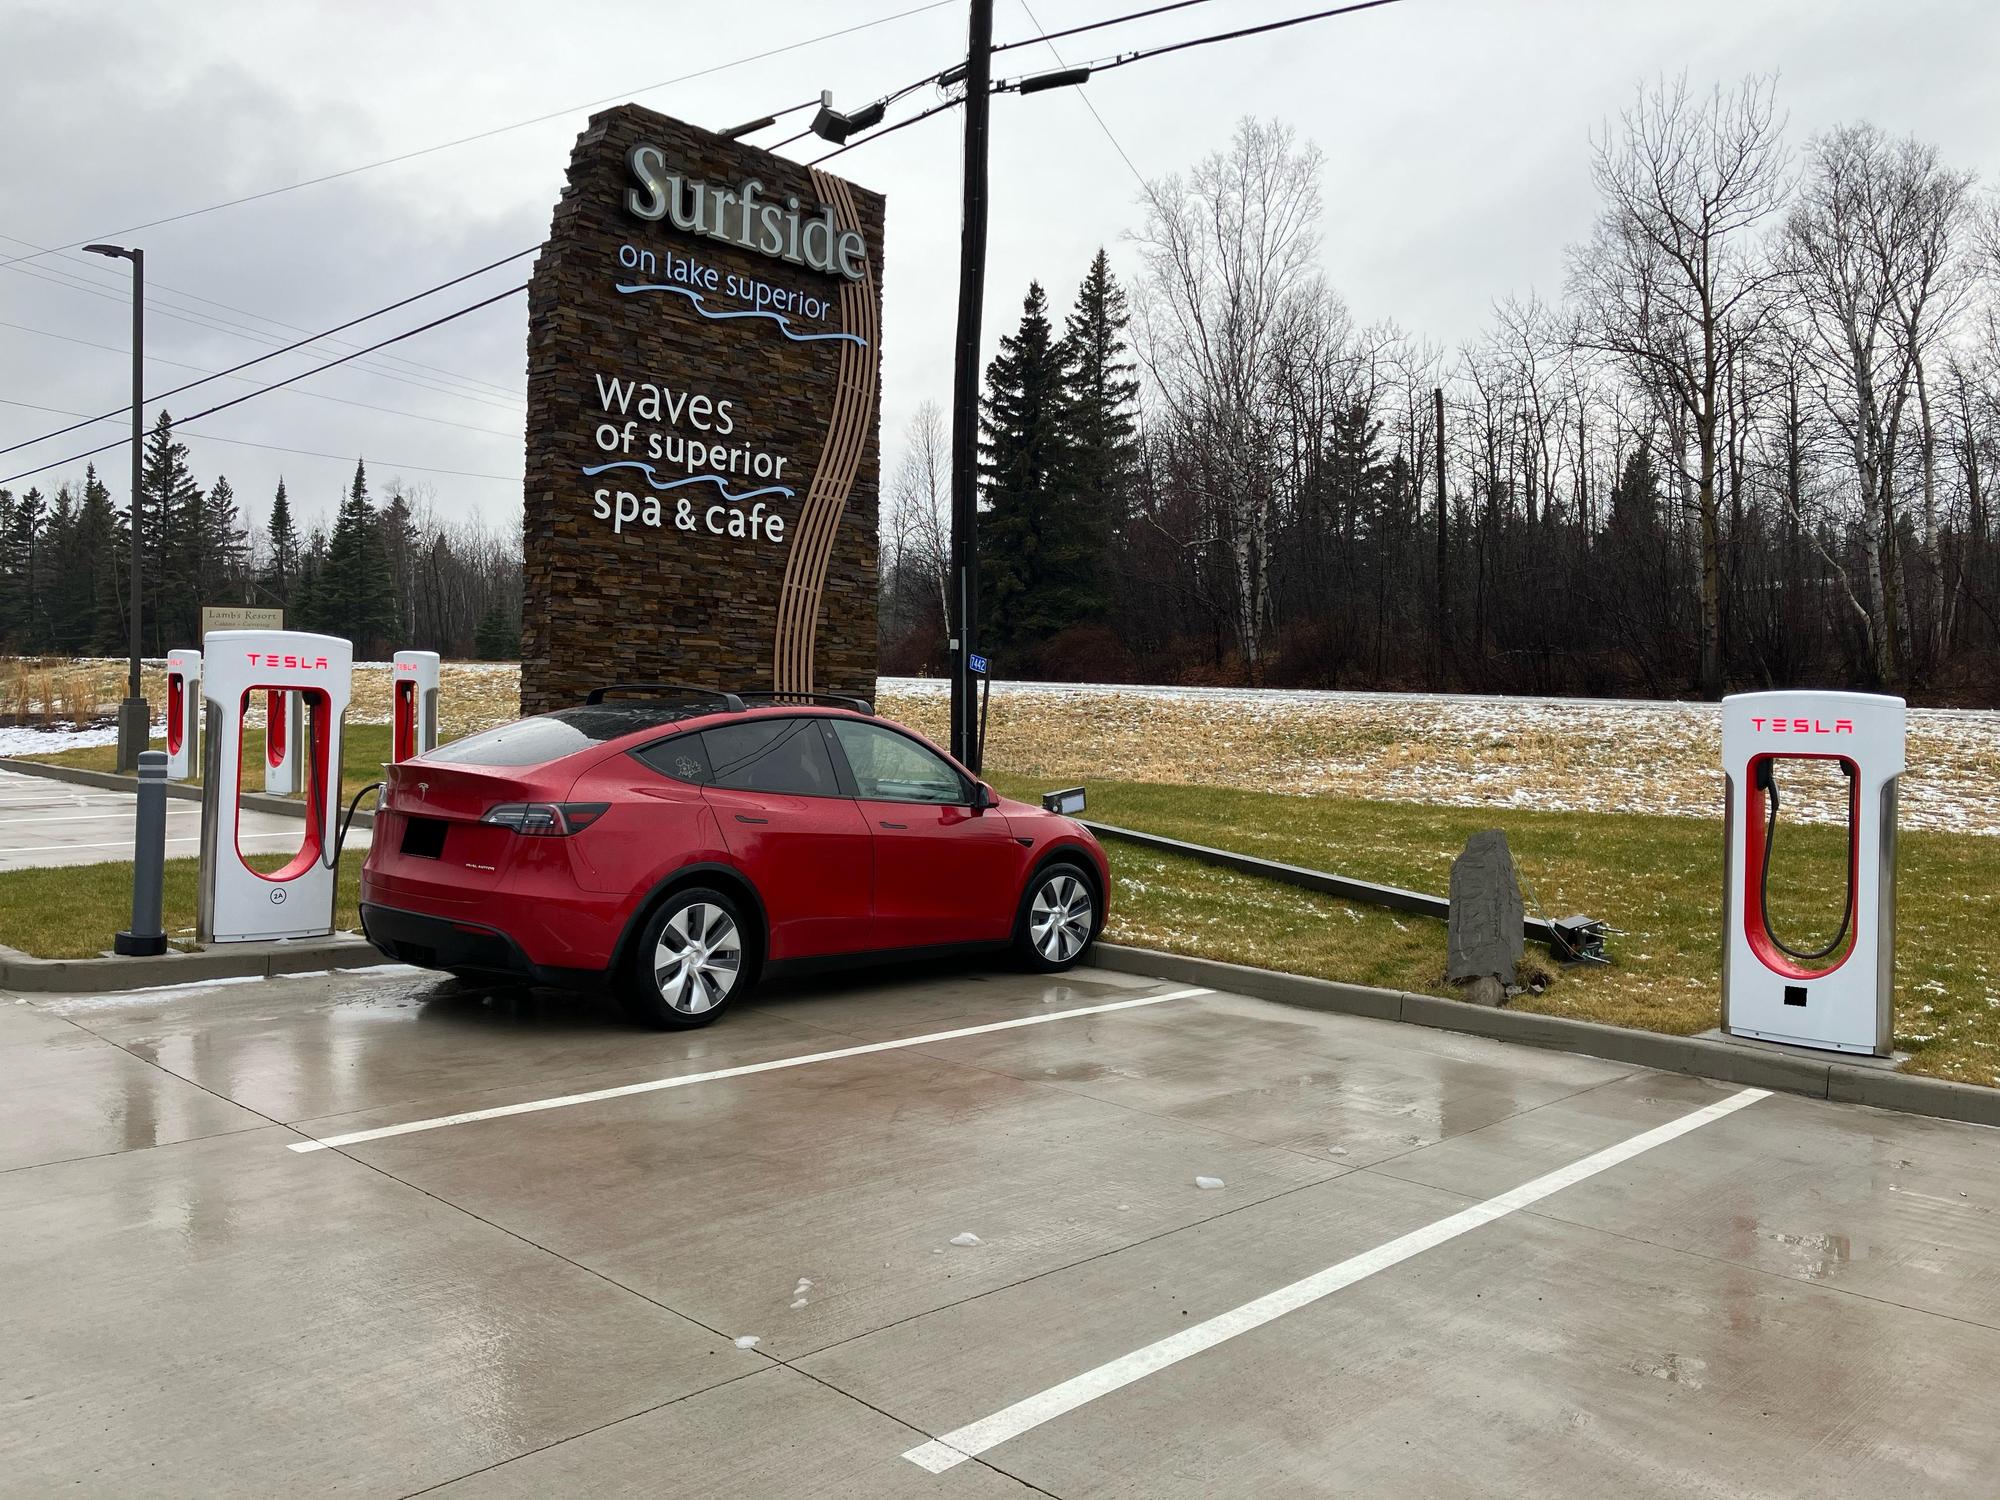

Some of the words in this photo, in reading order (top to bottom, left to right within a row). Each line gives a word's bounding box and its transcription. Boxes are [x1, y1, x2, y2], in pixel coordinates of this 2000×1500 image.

[630, 145, 866, 281] Surfside
[619, 244, 656, 275] on
[666, 251, 719, 290] lake
[726, 273, 831, 321] superior
[595, 373, 734, 435] waves
[595, 421, 638, 454] of
[648, 432, 788, 480] superior
[593, 488, 662, 534] spa
[674, 498, 697, 531] &
[705, 502, 785, 543] cafe
[245, 610, 277, 620] Resort
[247, 653, 328, 670] TESLA
[396, 663, 418, 671] TESLA
[970, 656, 986, 671] 7442
[1751, 718, 1853, 734] TESLA
[273, 892, 284, 900] 2A
